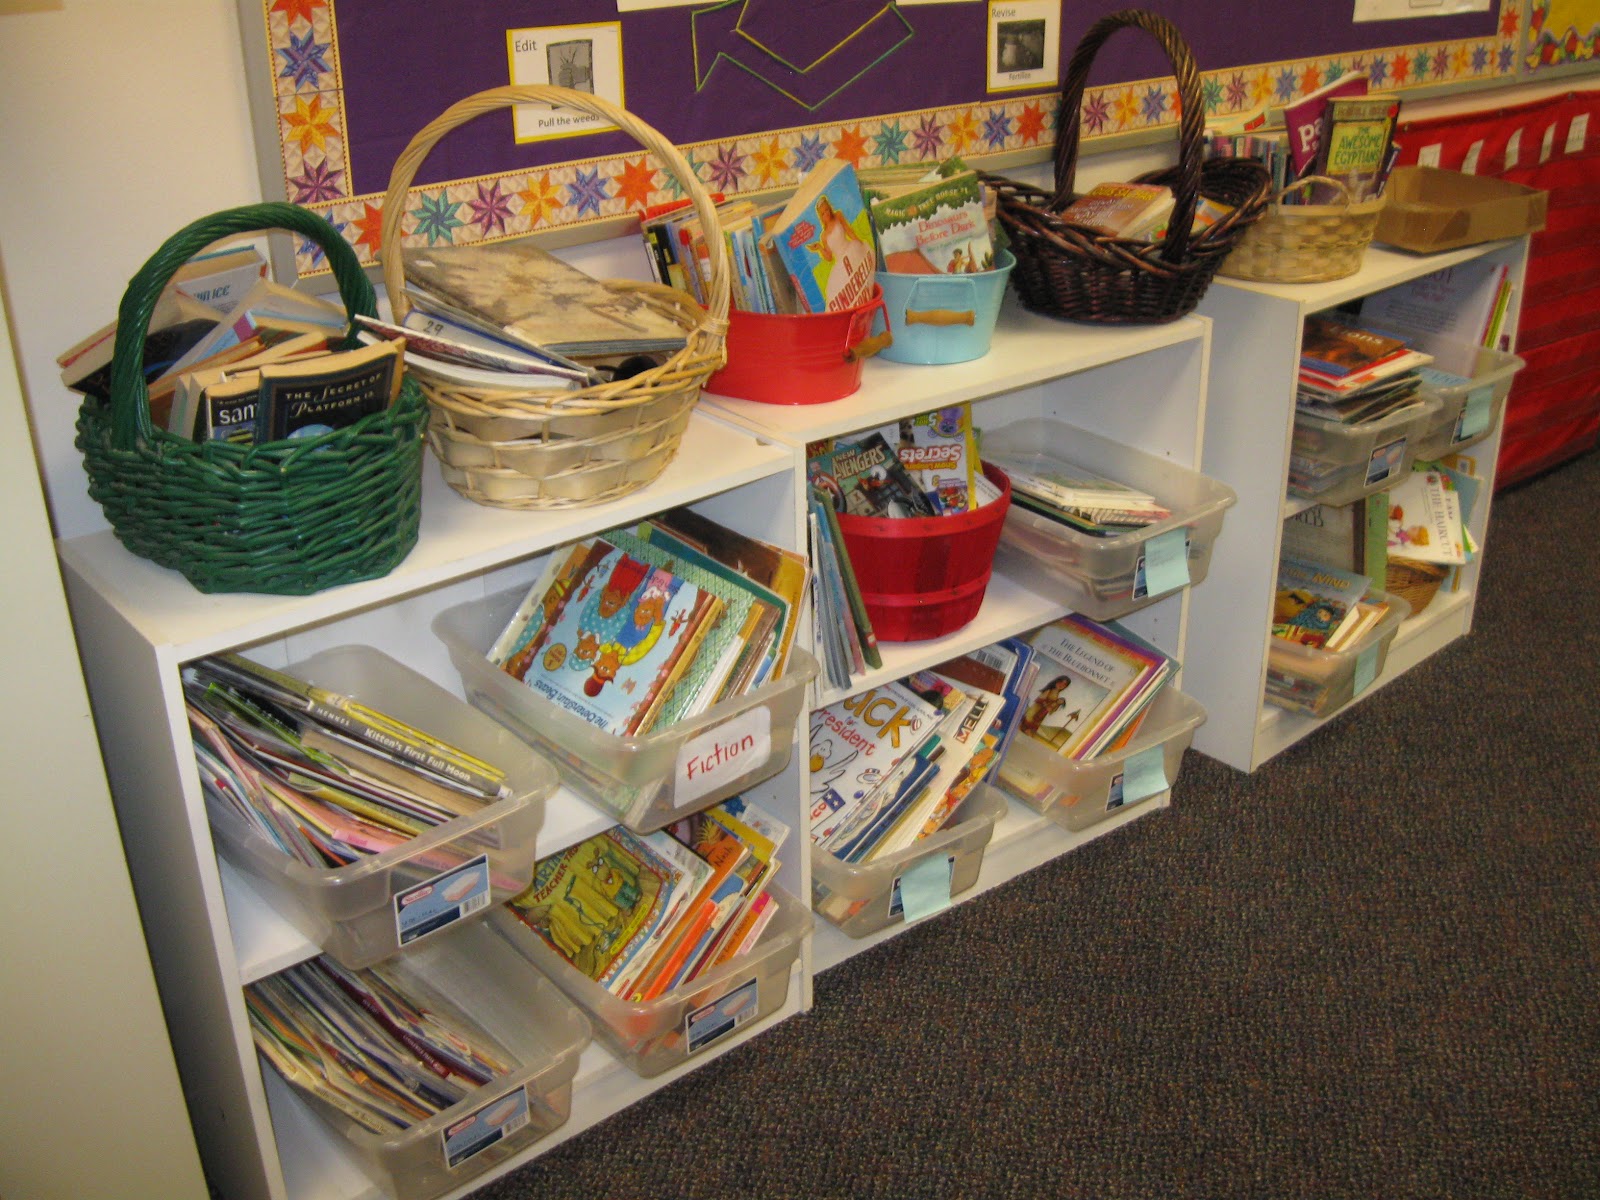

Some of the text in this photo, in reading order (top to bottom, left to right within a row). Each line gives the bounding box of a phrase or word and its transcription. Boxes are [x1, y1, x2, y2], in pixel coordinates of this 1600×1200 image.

[992, 9, 1016, 18] Revise
[515, 39, 537, 53] Edit
[538, 114, 600, 128] Pull the weeds
[1339, 132, 1380, 149] AWESOME
[1335, 149, 1380, 165] EGYPTIANS
[916, 230, 949, 247] Before
[951, 219, 976, 235] Dark
[918, 211, 968, 233] Dinosaurs
[843, 255, 853, 277] A
[829, 250, 873, 312] CINDERELLA
[286, 373, 382, 402] THE SECRET OF
[290, 396, 360, 417] PLATFORM
[832, 444, 886, 479] AVENGERS
[835, 449, 856, 461] NEW
[900, 444, 962, 462] Secrets
[1048, 645, 1111, 683] THE BLUEBONNET
[1060, 638, 1115, 673] THE LEGEND OF
[811, 708, 876, 757] resident
[363, 727, 403, 751] Kitten's
[404, 746, 426, 762] First
[427, 755, 445, 770] Full
[446, 764, 471, 782] Moon
[687, 734, 754, 781] Fiction
[533, 862, 568, 903] TEACHER
